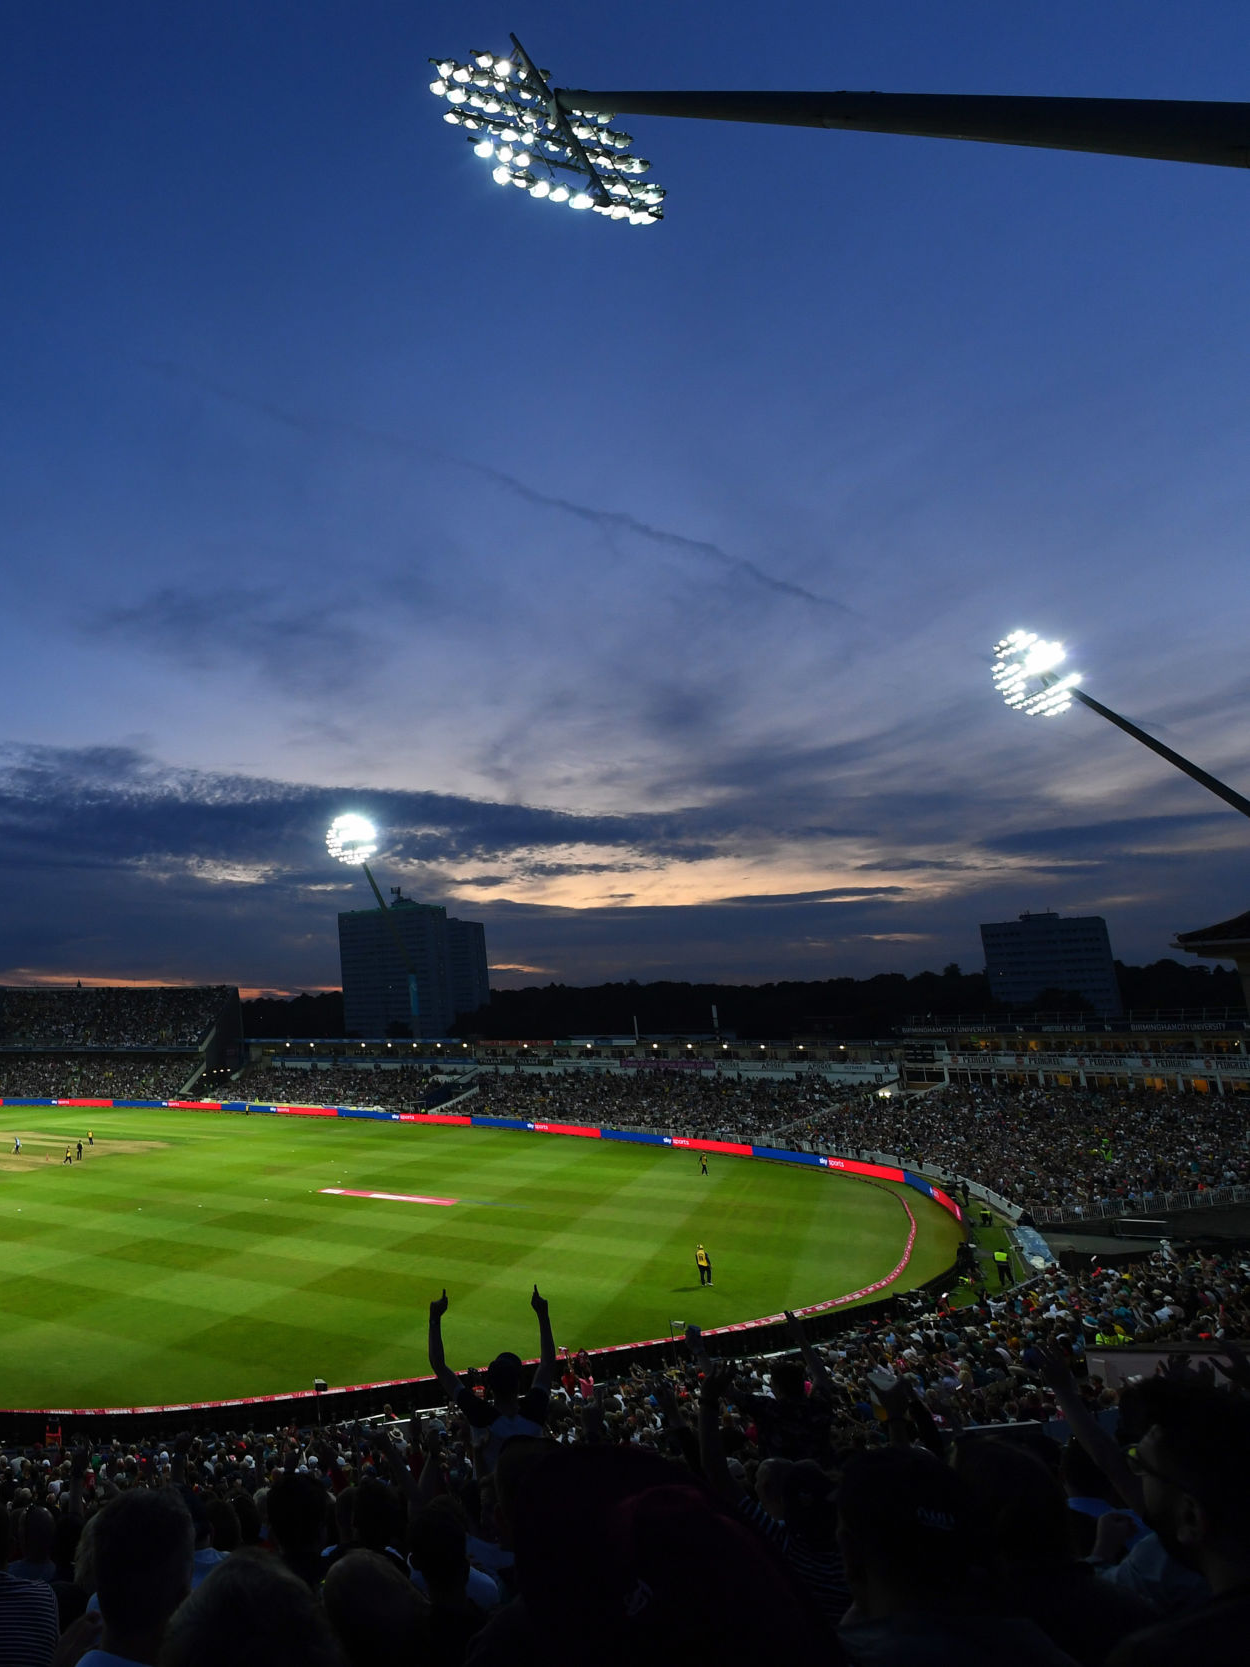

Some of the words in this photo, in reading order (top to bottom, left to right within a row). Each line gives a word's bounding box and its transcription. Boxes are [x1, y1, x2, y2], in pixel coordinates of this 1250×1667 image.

[1190, 1023, 1226, 1031] UNIVERSITY
[819, 1158, 827, 1166] sky
[828, 1159, 844, 1168] sports
